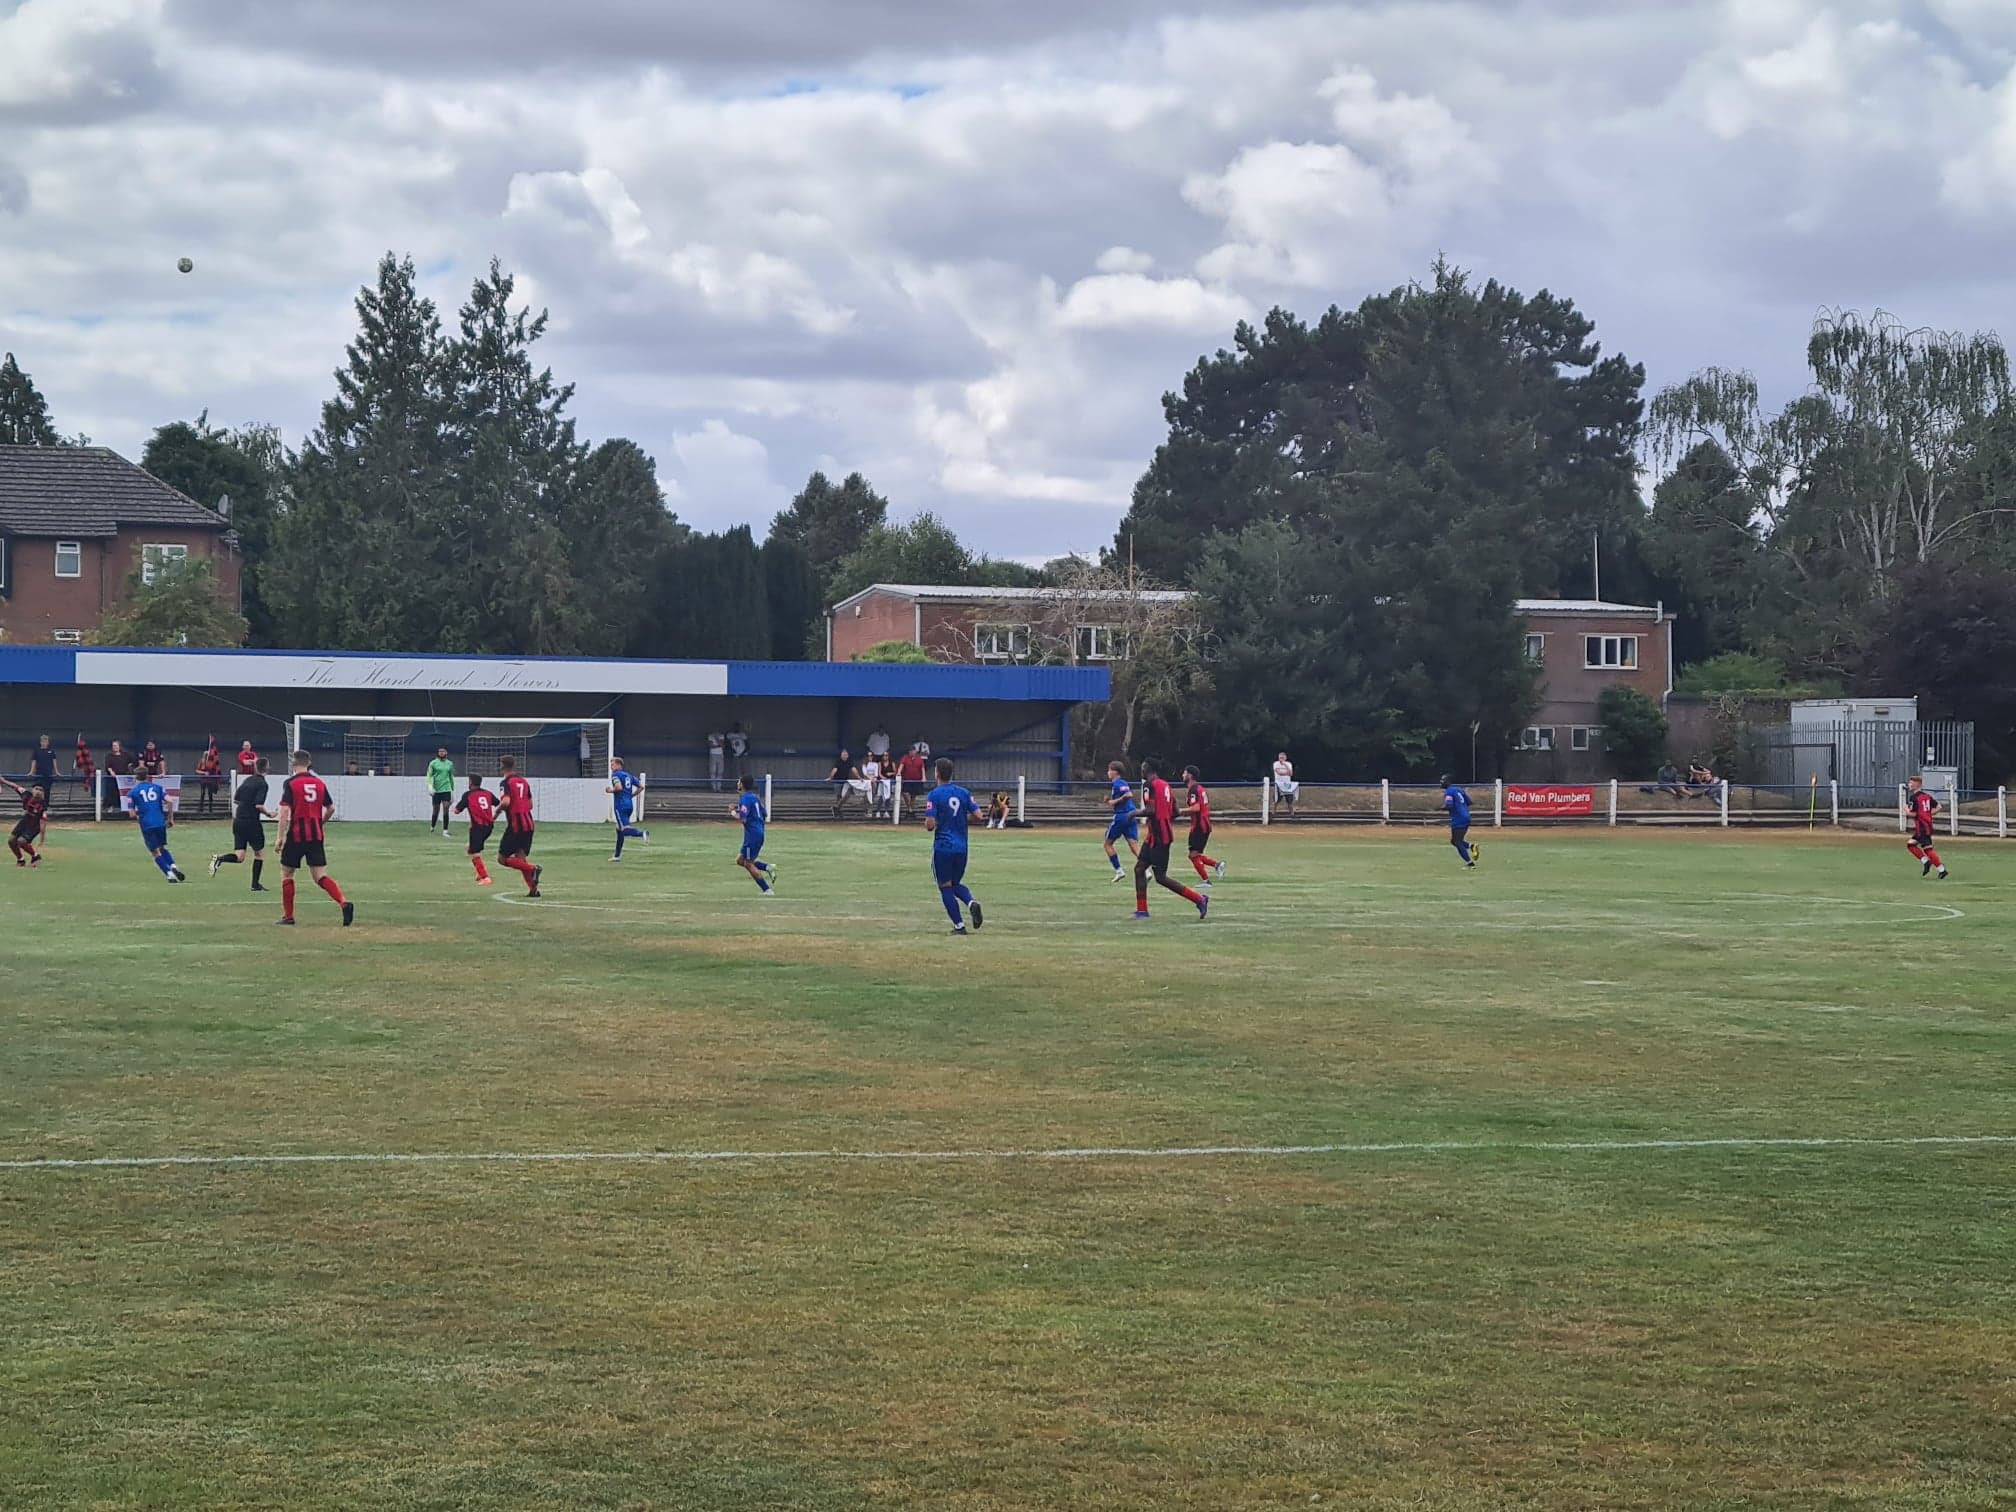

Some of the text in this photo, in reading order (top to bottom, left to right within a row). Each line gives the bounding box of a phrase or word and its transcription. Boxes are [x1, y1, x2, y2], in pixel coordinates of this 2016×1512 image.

[294, 660, 336, 685] The
[358, 662, 425, 686] Hand
[430, 670, 475, 688] and
[140, 787, 158, 803] 16
[303, 783, 317, 802] 5
[516, 782, 525, 799] 7
[1507, 791, 1591, 803] Red Van Plumbers
[478, 796, 489, 810] 9
[948, 796, 961, 817] 9
[1922, 799, 1931, 812] 14
